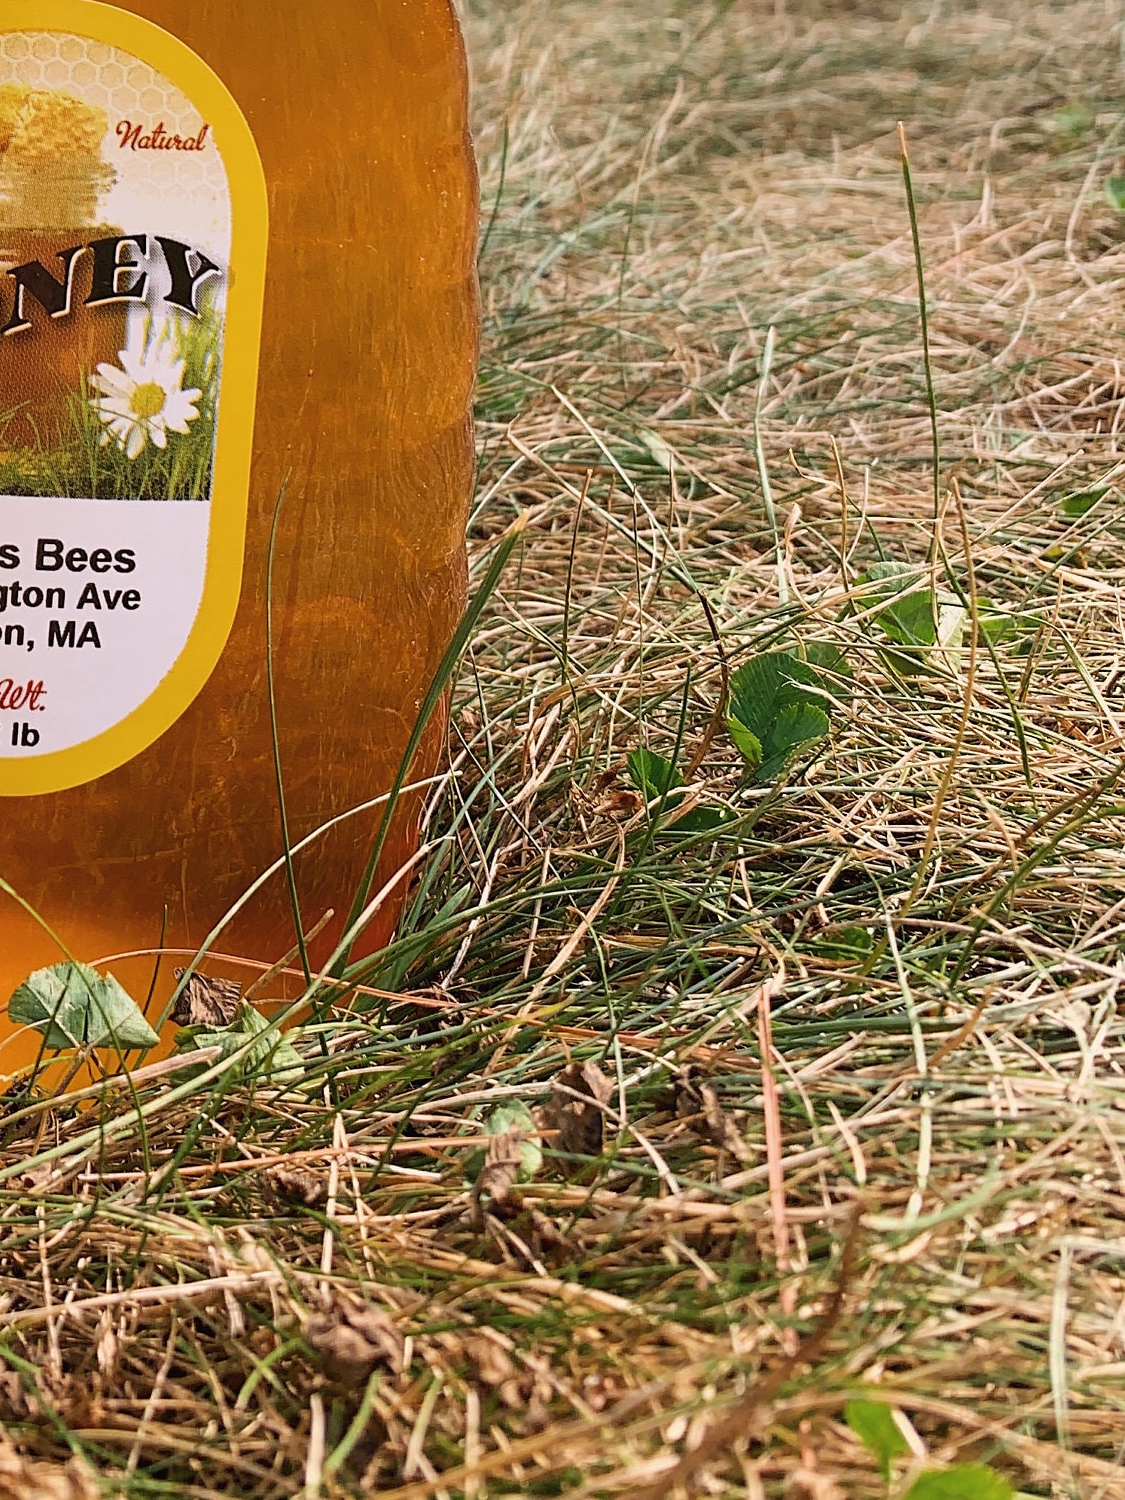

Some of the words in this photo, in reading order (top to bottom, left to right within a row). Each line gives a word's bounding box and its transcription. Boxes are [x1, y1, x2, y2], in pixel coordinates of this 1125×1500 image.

[116, 120, 210, 152] Natural
[35, 537, 136, 574] Bees
[76, 583, 141, 611] Ave
[47, 620, 101, 649] MA
[12, 721, 41, 748] lb
